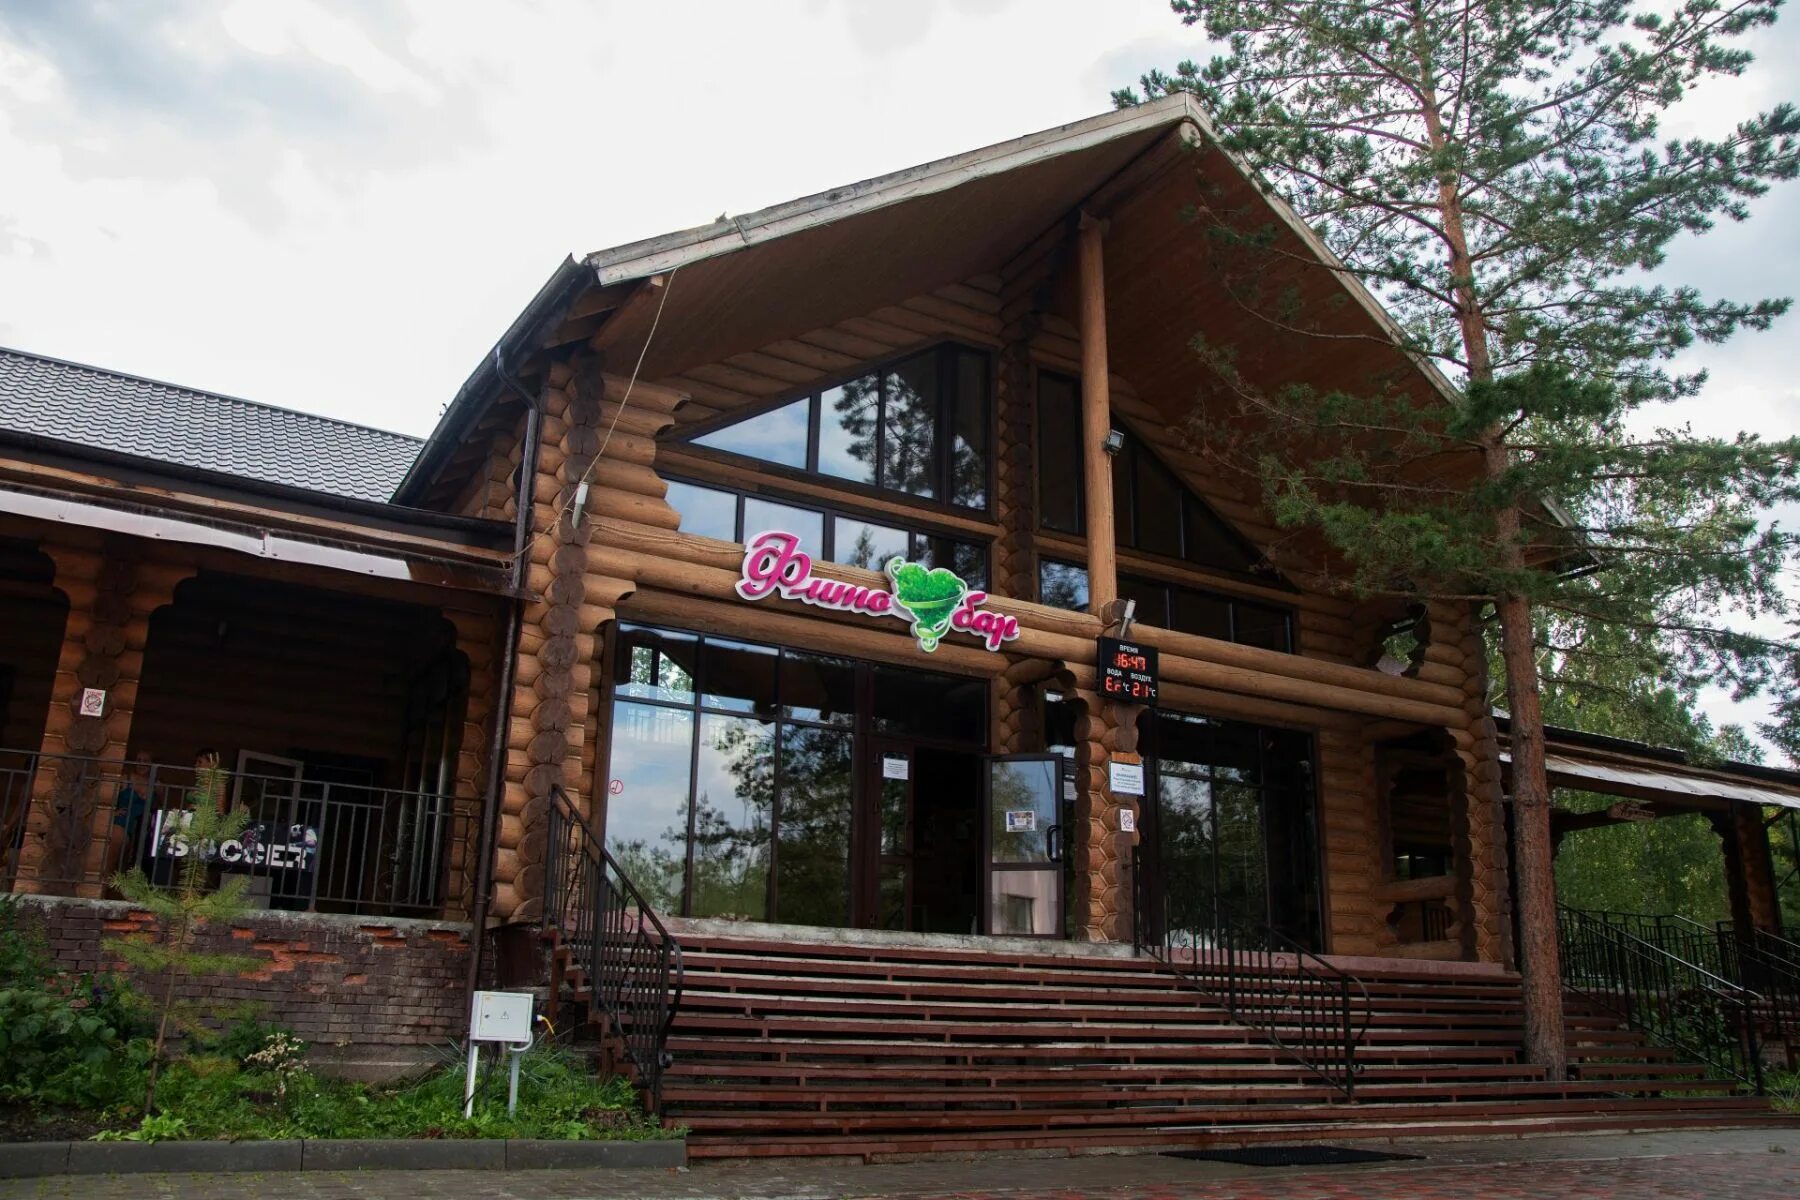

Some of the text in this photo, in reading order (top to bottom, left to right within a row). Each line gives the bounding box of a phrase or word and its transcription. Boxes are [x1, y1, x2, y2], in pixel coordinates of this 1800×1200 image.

[739, 532, 1019, 650] Фито бар
[1119, 644, 1139, 654] ВРЕМЯ
[1115, 653, 1146, 671] 16:47
[1106, 667, 1152, 683] ВОДА ВОЗДУХ
[1132, 682, 1149, 698] 21
